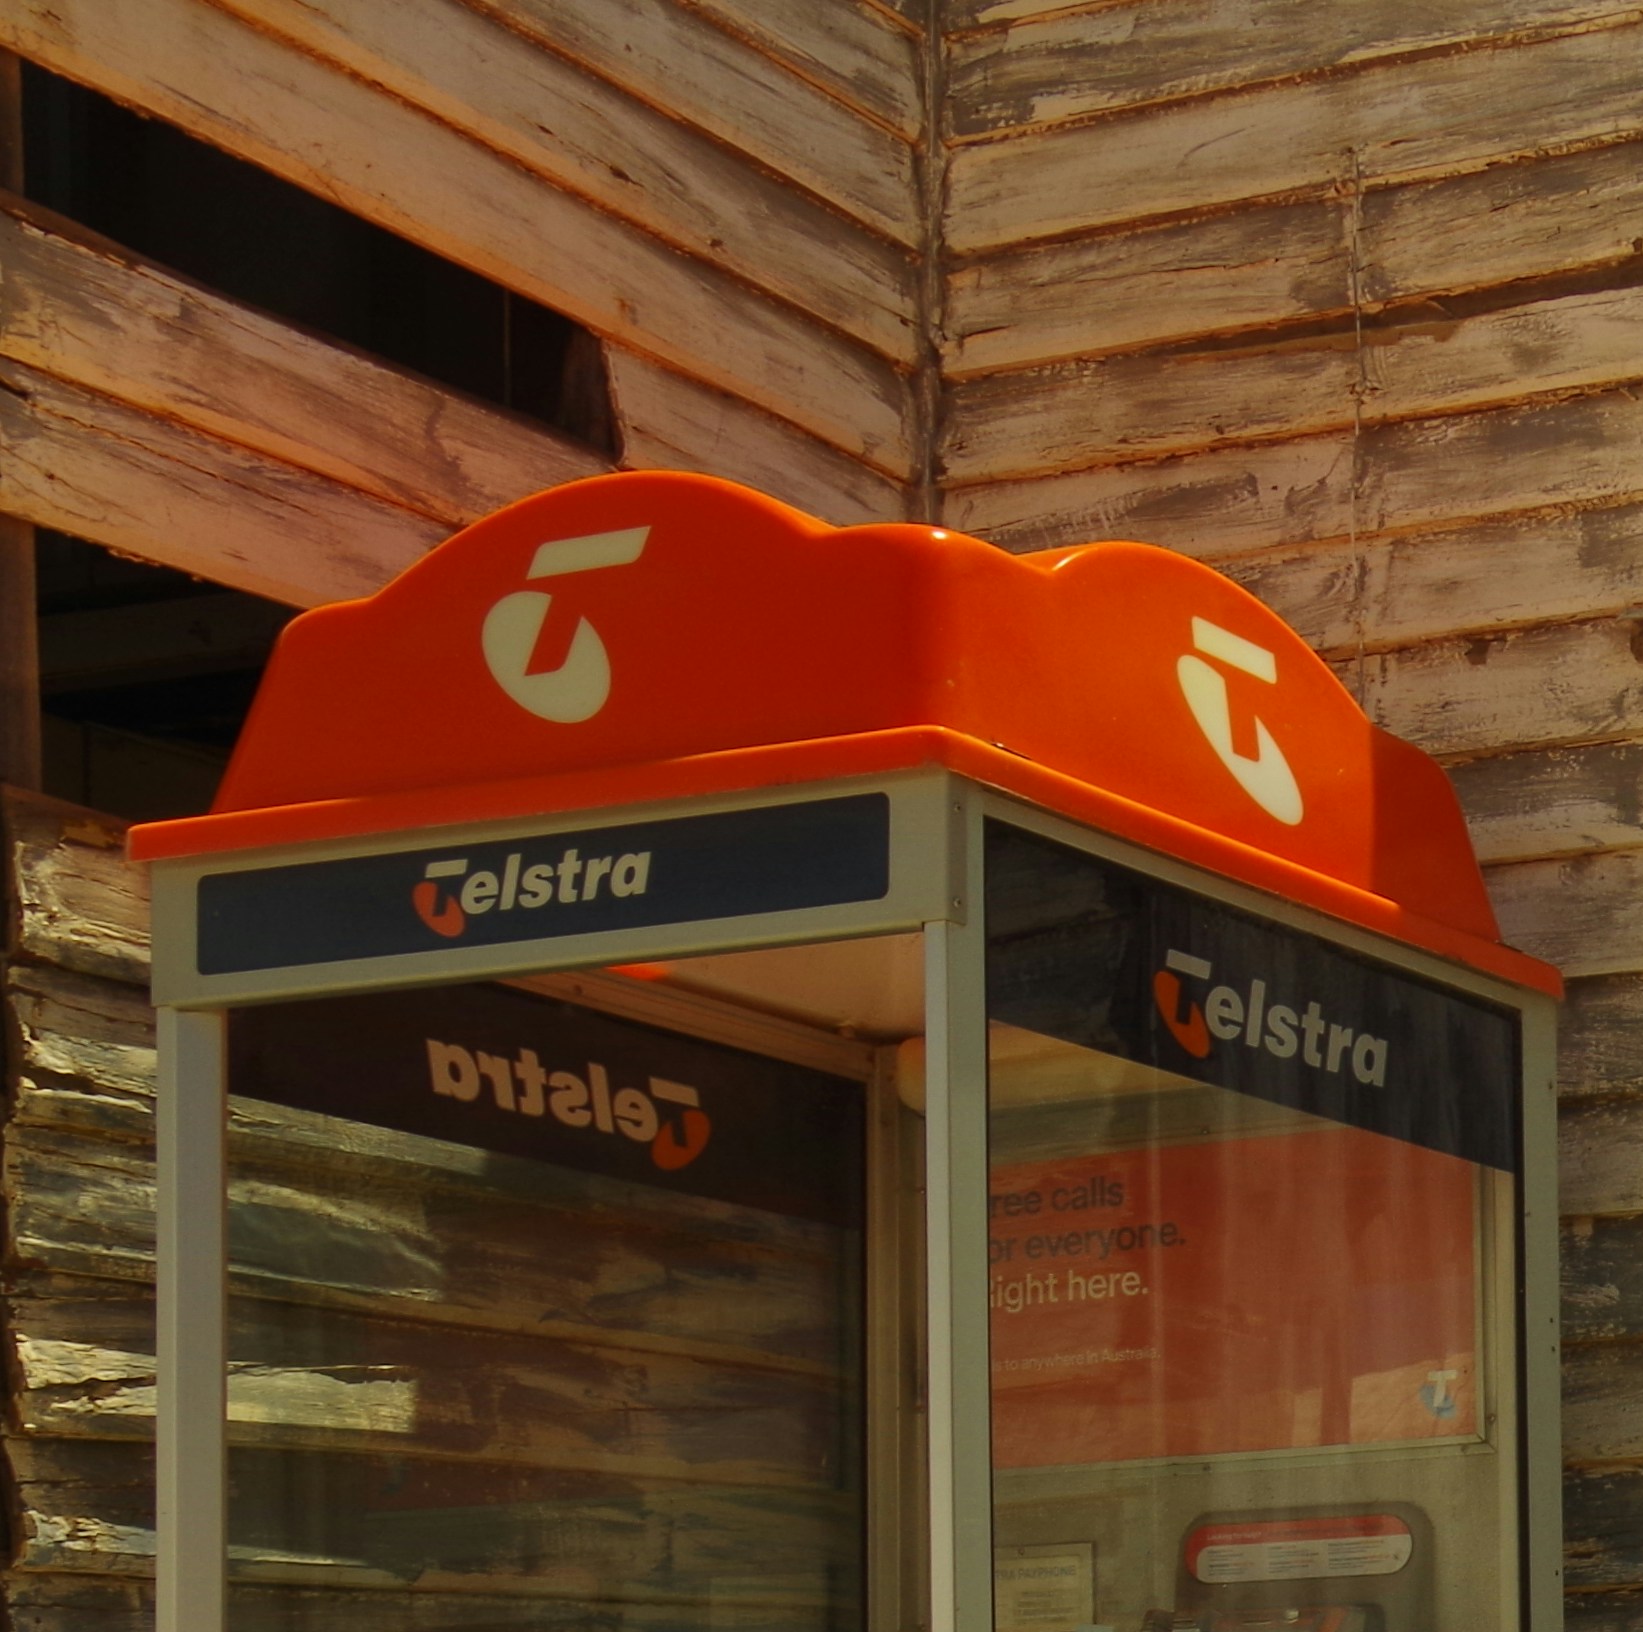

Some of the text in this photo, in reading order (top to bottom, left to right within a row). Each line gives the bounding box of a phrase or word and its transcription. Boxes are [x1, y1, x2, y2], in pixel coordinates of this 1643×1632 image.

[412, 849, 651, 938] Telstra
[1153, 948, 1387, 1088] Telstra
[990, 1178, 1123, 1217] ree calls
[990, 1223, 1186, 1263] or everyone.
[991, 1270, 1148, 1313] ight here.
